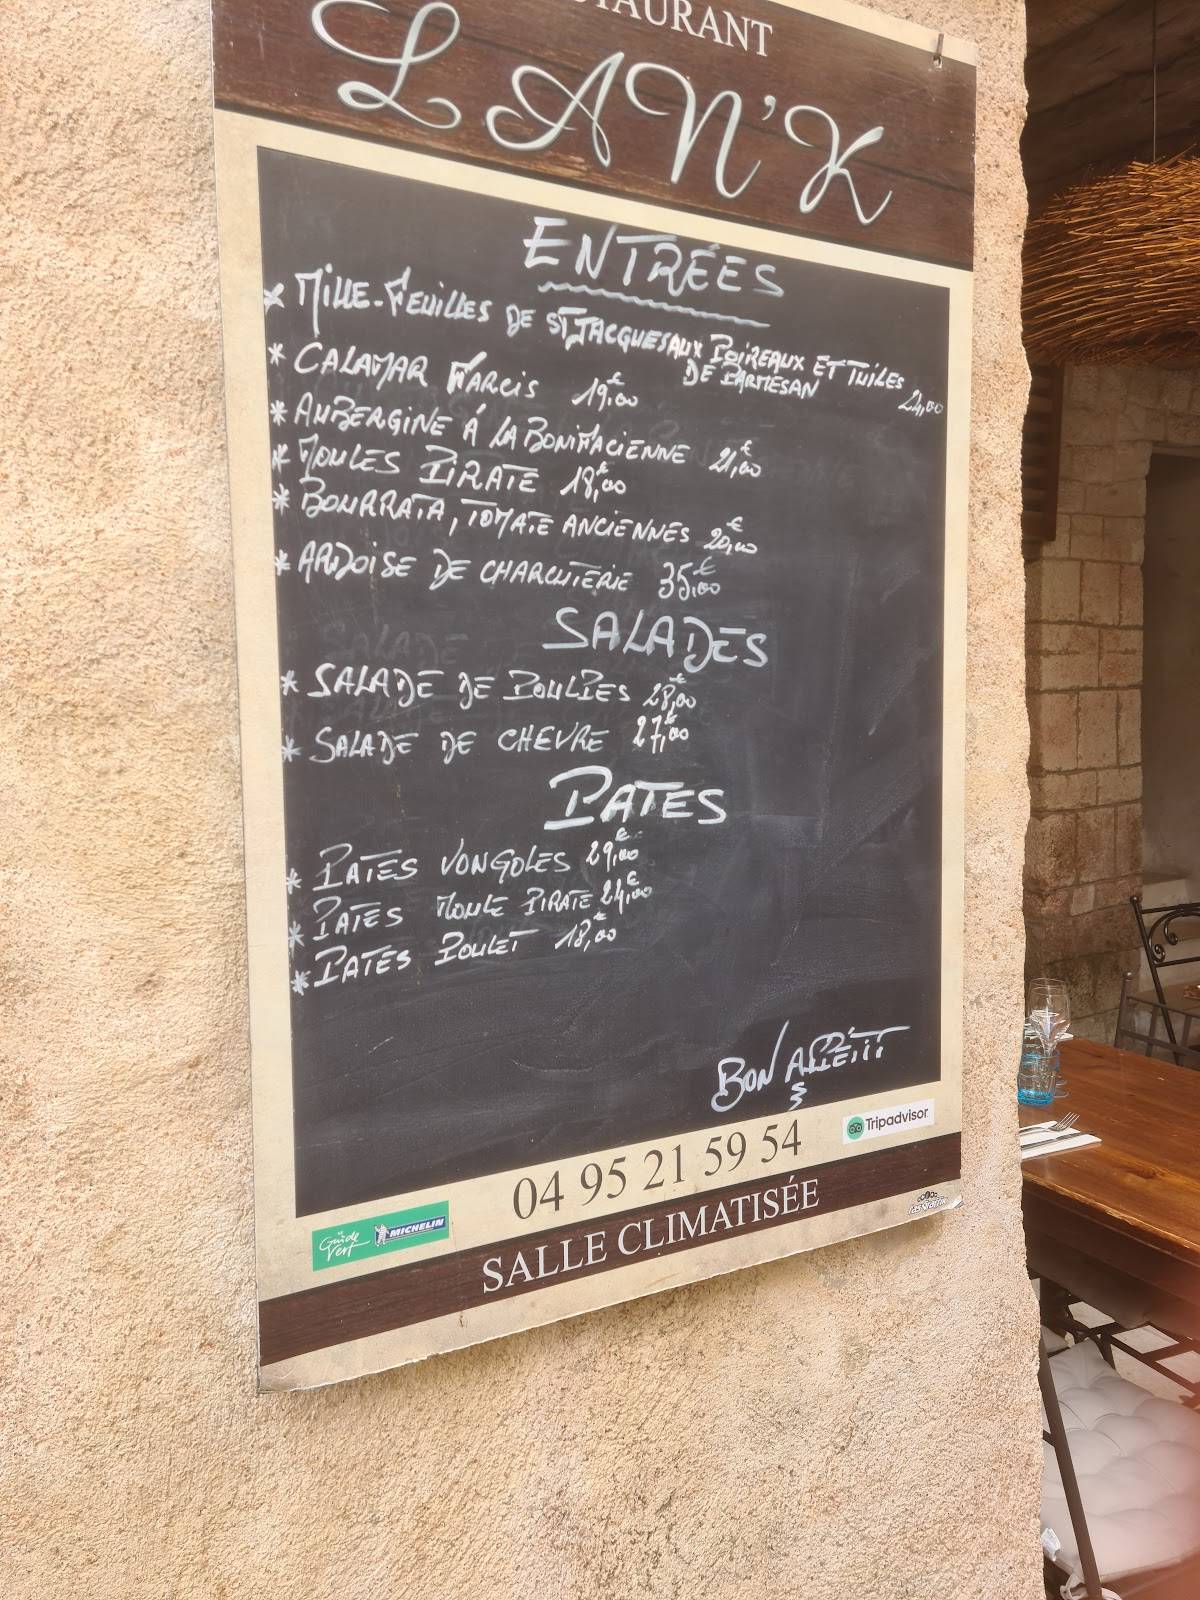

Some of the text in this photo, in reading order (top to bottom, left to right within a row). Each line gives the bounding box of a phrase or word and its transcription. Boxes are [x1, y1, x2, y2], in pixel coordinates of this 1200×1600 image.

[523, 216, 784, 297] ENTRÉES
[294, 342, 428, 391] CALAMAR
[505, 304, 536, 337] DE
[666, 332, 703, 360] AUX
[710, 334, 805, 374] POIREAUX
[813, 355, 846, 379] ET
[682, 357, 819, 399] DE PARMESAN
[294, 392, 453, 436] AUBERGINE
[489, 416, 518, 450] LA
[298, 433, 400, 478] MOULES
[419, 445, 538, 492] PIRATE
[461, 498, 554, 539] TOMATE
[562, 510, 690, 544] ANCIENNES
[298, 540, 416, 584] ARDOISE
[428, 548, 472, 591] DE
[480, 560, 633, 591] CHARCUTERIE
[542, 606, 768, 673] SALADES
[307, 663, 445, 708] SALADE
[458, 671, 495, 710] DE
[503, 669, 630, 701] POULPES
[309, 726, 419, 765] SALADE
[440, 731, 477, 764] DE
[498, 722, 609, 752] CHEVRE
[544, 765, 727, 830] PATES
[312, 843, 418, 891] PATES
[441, 838, 571, 884] VONGOLES
[312, 896, 403, 941] PATES
[436, 892, 509, 920] MOULE
[521, 887, 593, 916] PIRATE
[313, 945, 411, 987] PATES
[434, 929, 539, 966] POULET
[711, 1020, 789, 1113] BON
[865, 1108, 929, 1131] Tripadvisor
[513, 1119, 802, 1219] 04 95 21 59 54
[319, 1230, 360, 1251] Guide
[389, 1218, 444, 1238] MICHELIN
[483, 1175, 820, 1293] SALLE CLIMATISÉE
